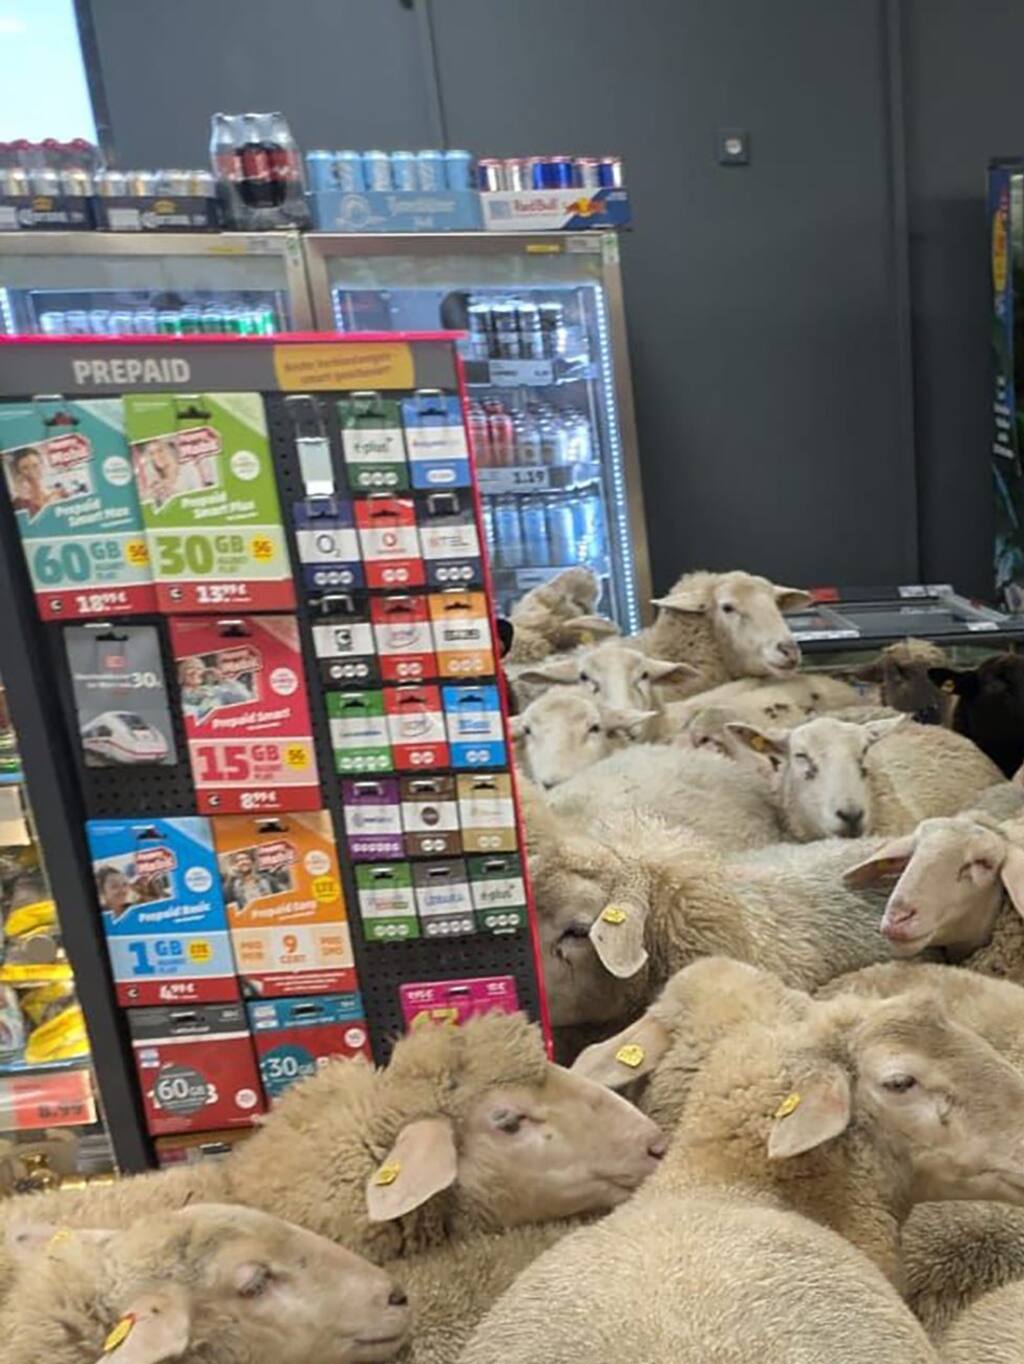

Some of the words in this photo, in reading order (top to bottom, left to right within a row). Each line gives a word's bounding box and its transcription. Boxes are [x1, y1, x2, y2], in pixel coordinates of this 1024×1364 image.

[73, 358, 191, 384] PREPAID
[34, 543, 91, 584] 60
[91, 541, 120, 560] GB
[157, 534, 214, 575] 30
[215, 534, 245, 553] GB
[197, 745, 249, 781] 15
[251, 744, 279, 761] GB
[129, 942, 155, 975] 1
[155, 940, 182, 956] GB
[282, 934, 298, 954] 9
[266, 1056, 298, 1079] 30
[157, 1078, 189, 1101] 60
